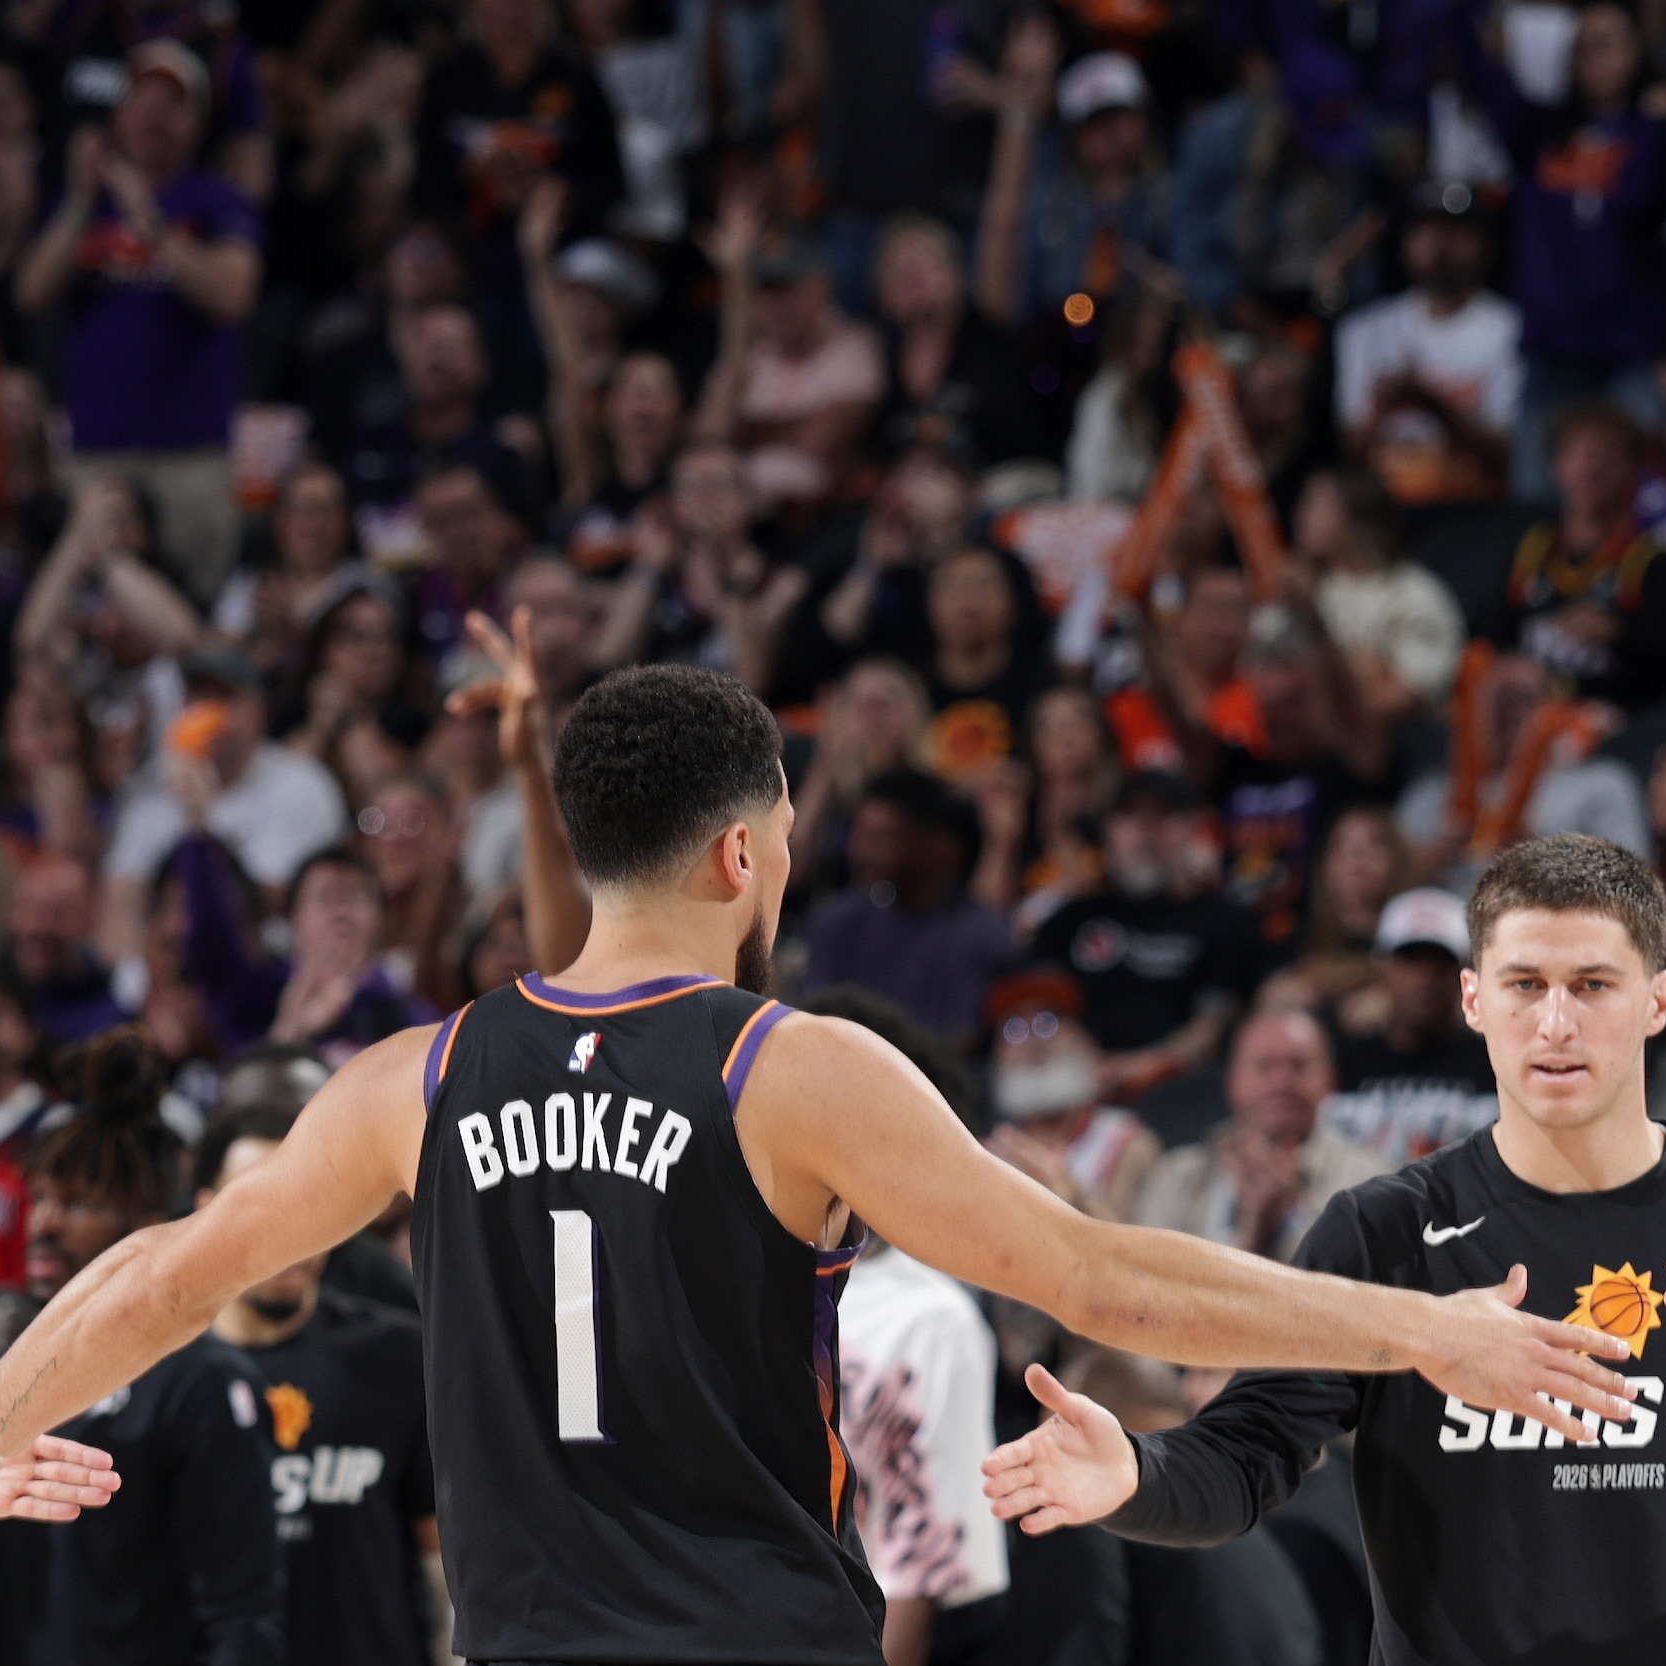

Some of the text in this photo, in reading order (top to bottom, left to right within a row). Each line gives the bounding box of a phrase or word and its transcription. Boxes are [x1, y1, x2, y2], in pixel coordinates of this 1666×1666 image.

[458, 1091, 693, 1194] BOOKER
[548, 1208, 616, 1444] 1
[1552, 1462, 1666, 1491] 2026 PLAYOFFS
